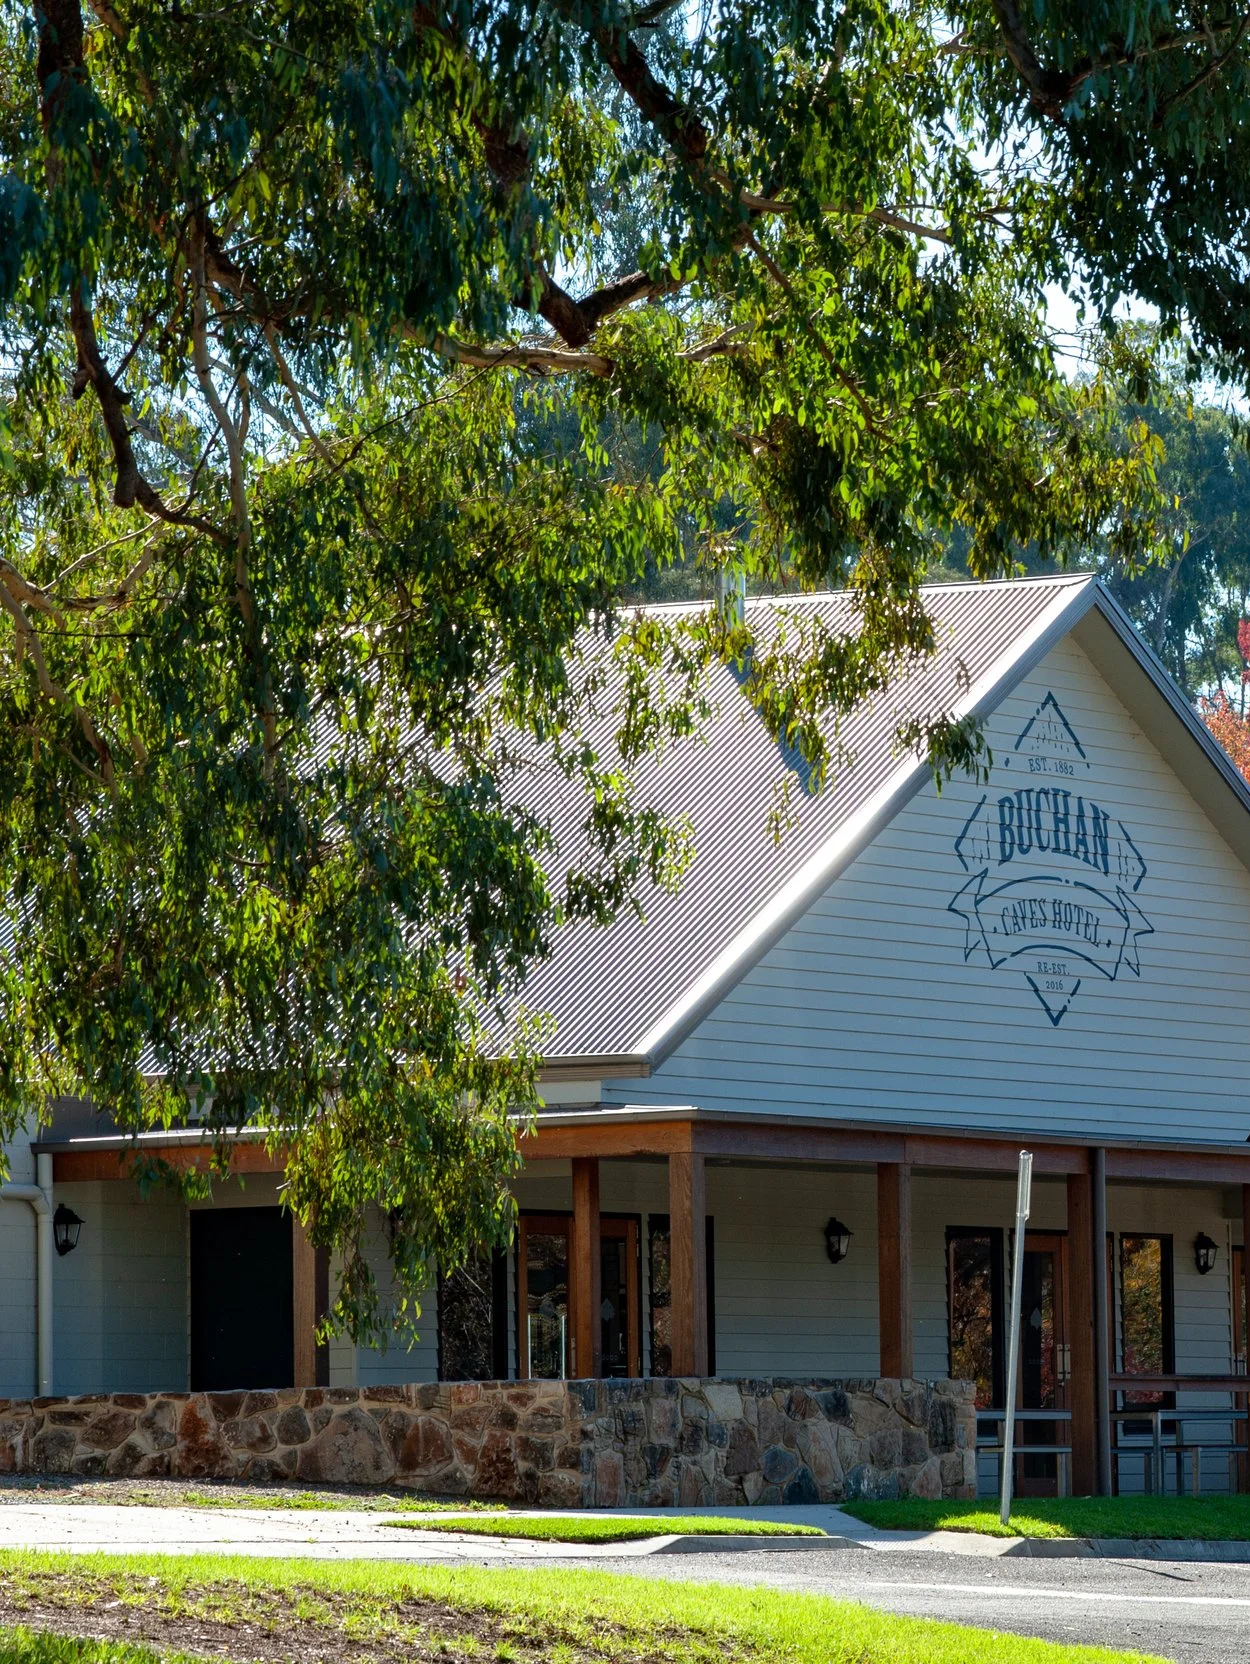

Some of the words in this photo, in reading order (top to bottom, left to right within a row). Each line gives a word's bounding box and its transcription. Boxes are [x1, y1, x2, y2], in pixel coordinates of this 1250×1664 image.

[1028, 758, 1051, 772] EST.
[1054, 760, 1074, 776] 1882
[998, 787, 1110, 877] BUCHAN
[1001, 898, 1048, 936] CAVES
[1052, 899, 1101, 948] HOTEL
[1037, 961, 1070, 976] RE-EST.
[1045, 980, 1064, 991] 2016
